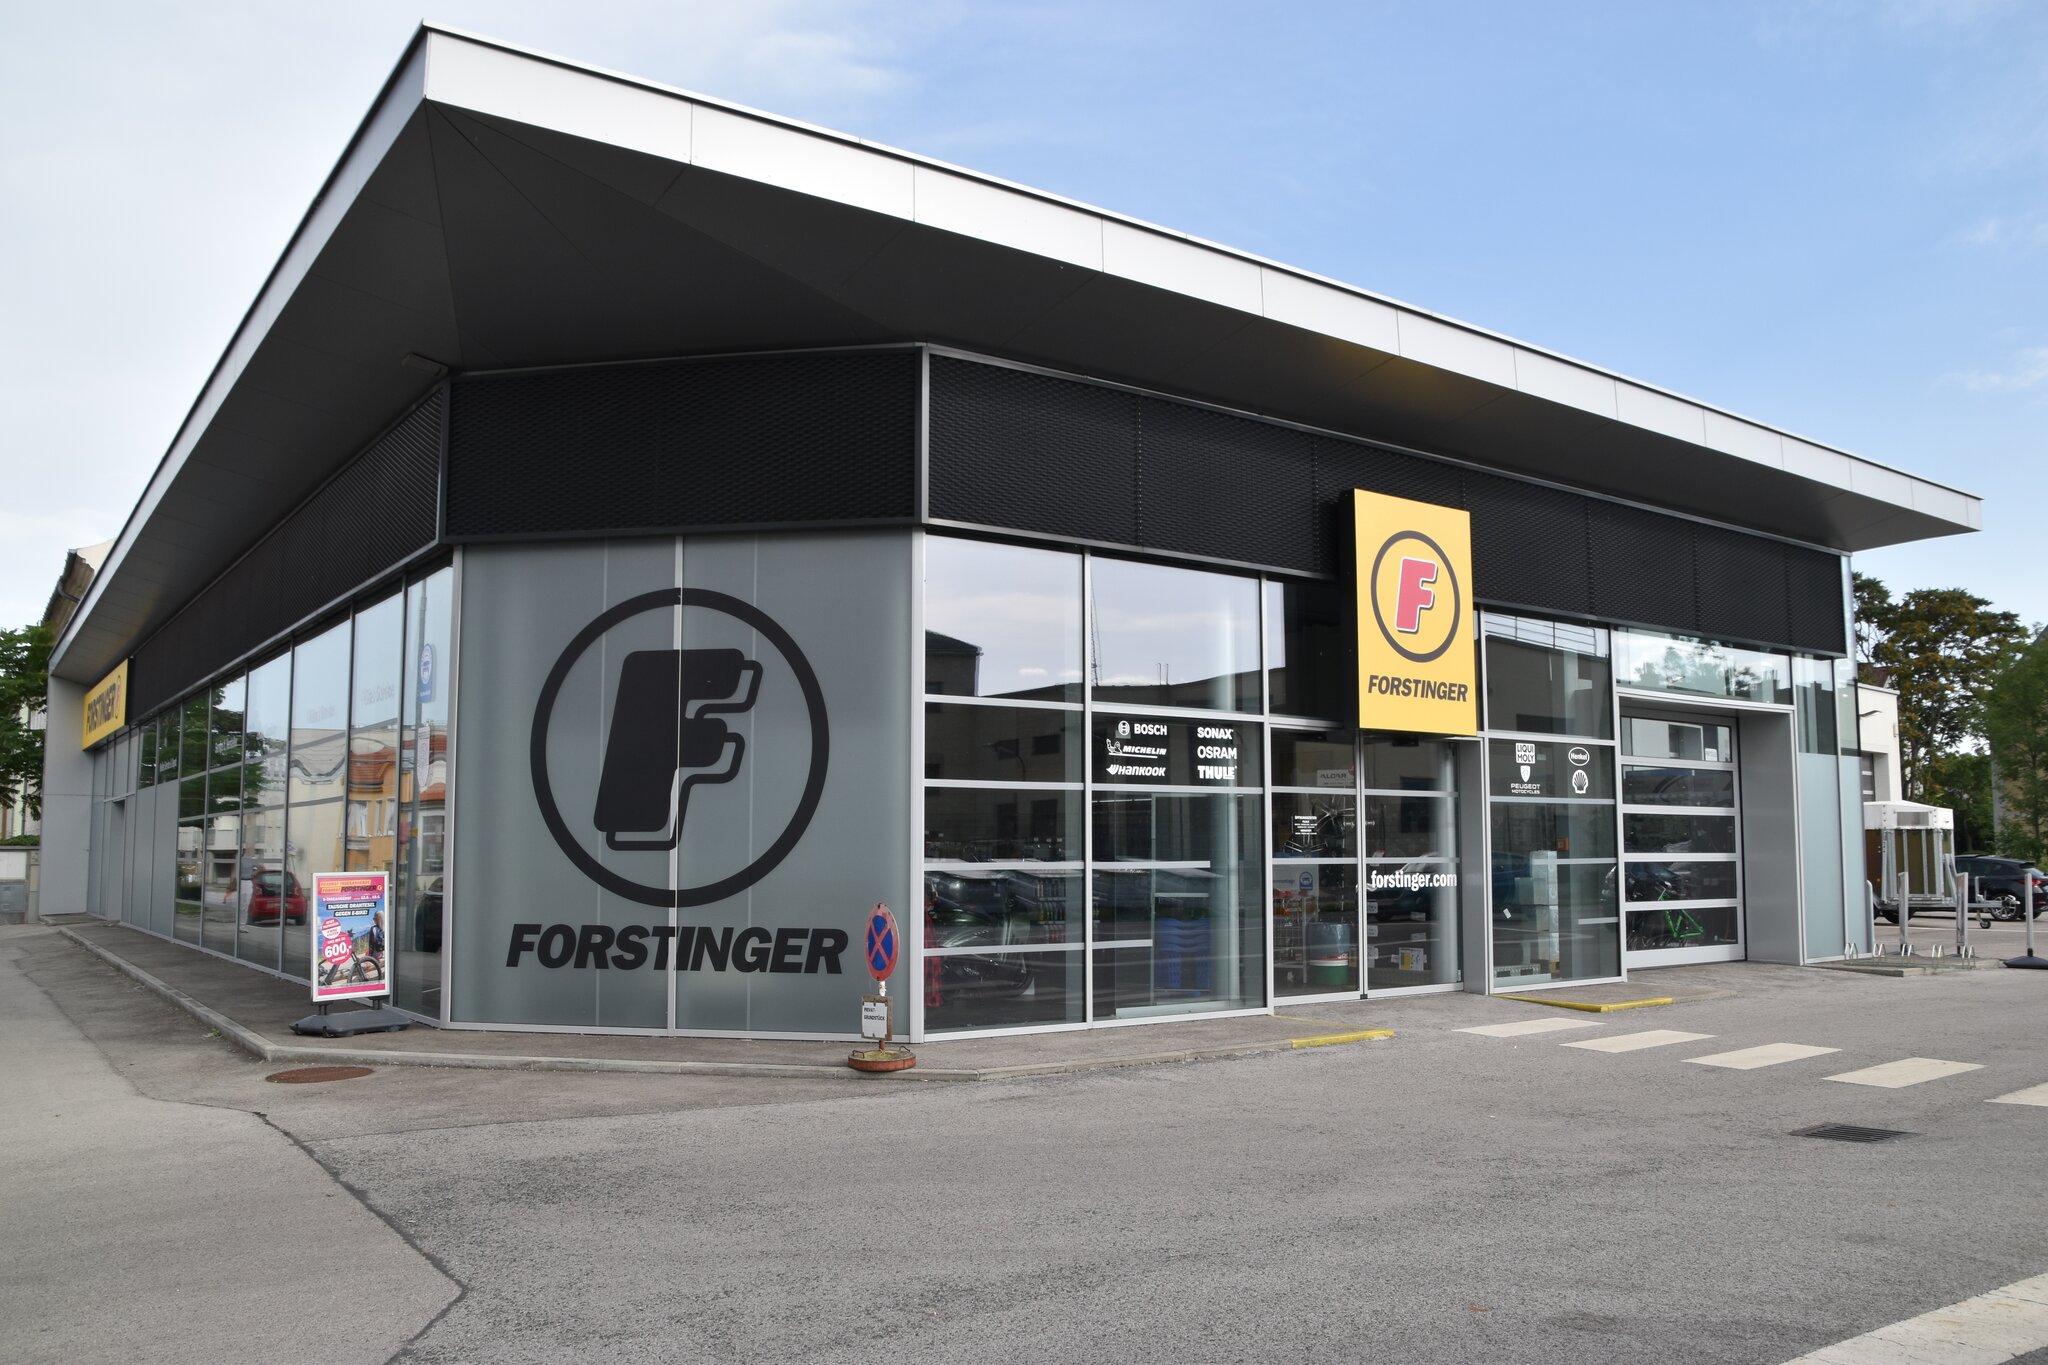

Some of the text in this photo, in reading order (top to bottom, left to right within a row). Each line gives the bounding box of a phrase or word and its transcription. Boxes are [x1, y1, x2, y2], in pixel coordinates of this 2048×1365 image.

[1395, 556, 1438, 634] F
[1368, 674, 1468, 702] FORSTINGER
[86, 682, 116, 736] FORSTINGER
[1134, 723, 1168, 736] BOSCH
[1197, 727, 1233, 740] SONAX
[594, 648, 763, 851] F
[1123, 745, 1167, 756] MICHELIN
[1197, 746, 1237, 759] OSRAM
[1516, 744, 1534, 753] LIQUI
[1517, 754, 1534, 762] MOLY
[1570, 752, 1588, 760] Henkel
[1197, 765, 1236, 780] THULE
[1371, 870, 1457, 892] forstinger.com
[506, 923, 849, 974] FORSTINGER
